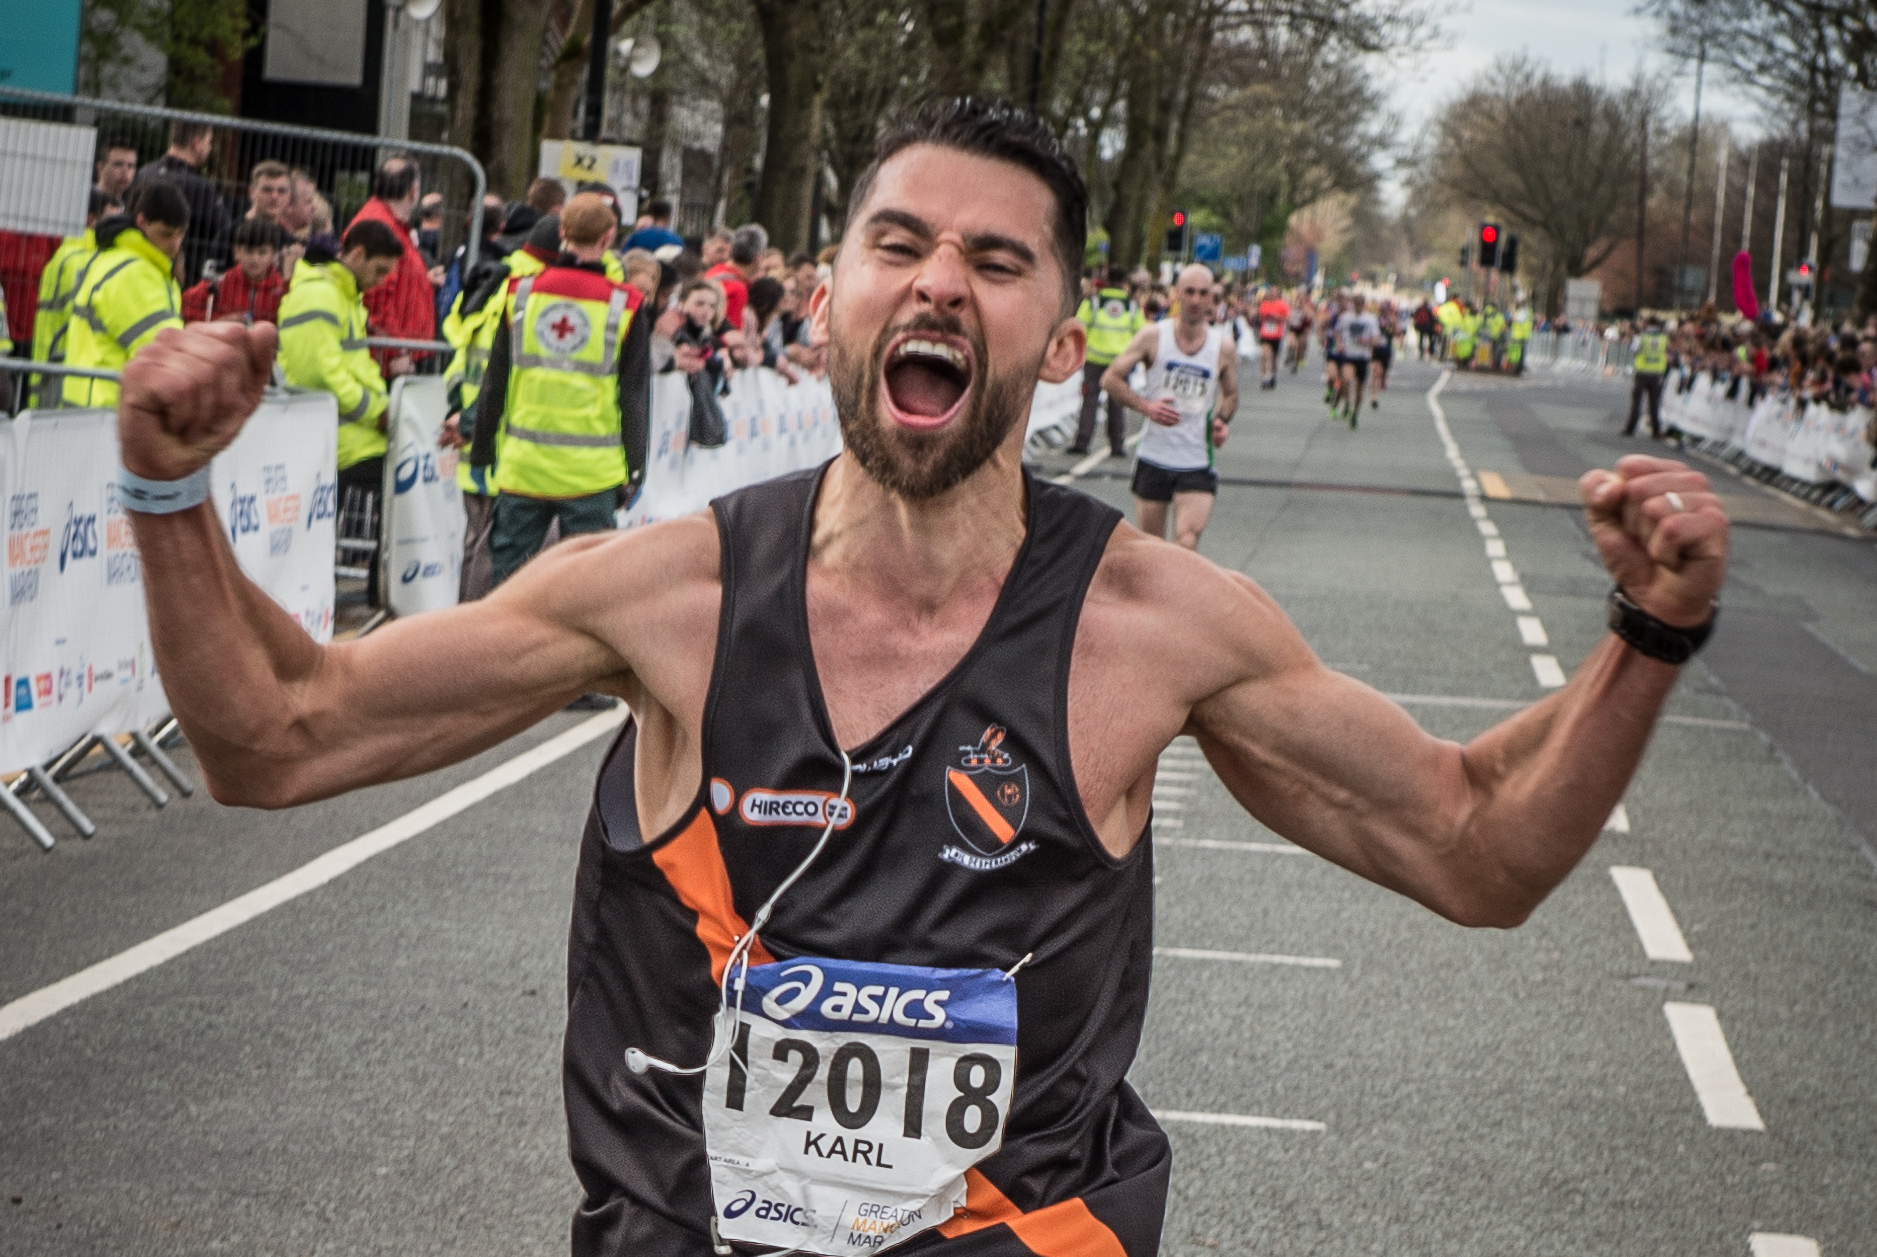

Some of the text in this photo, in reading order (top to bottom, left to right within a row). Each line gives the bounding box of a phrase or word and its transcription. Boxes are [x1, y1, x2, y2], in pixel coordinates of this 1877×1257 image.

[750, 798, 819, 817] HIRECO
[726, 1020, 1002, 1150] 12018
[803, 1130, 894, 1169] KARL
